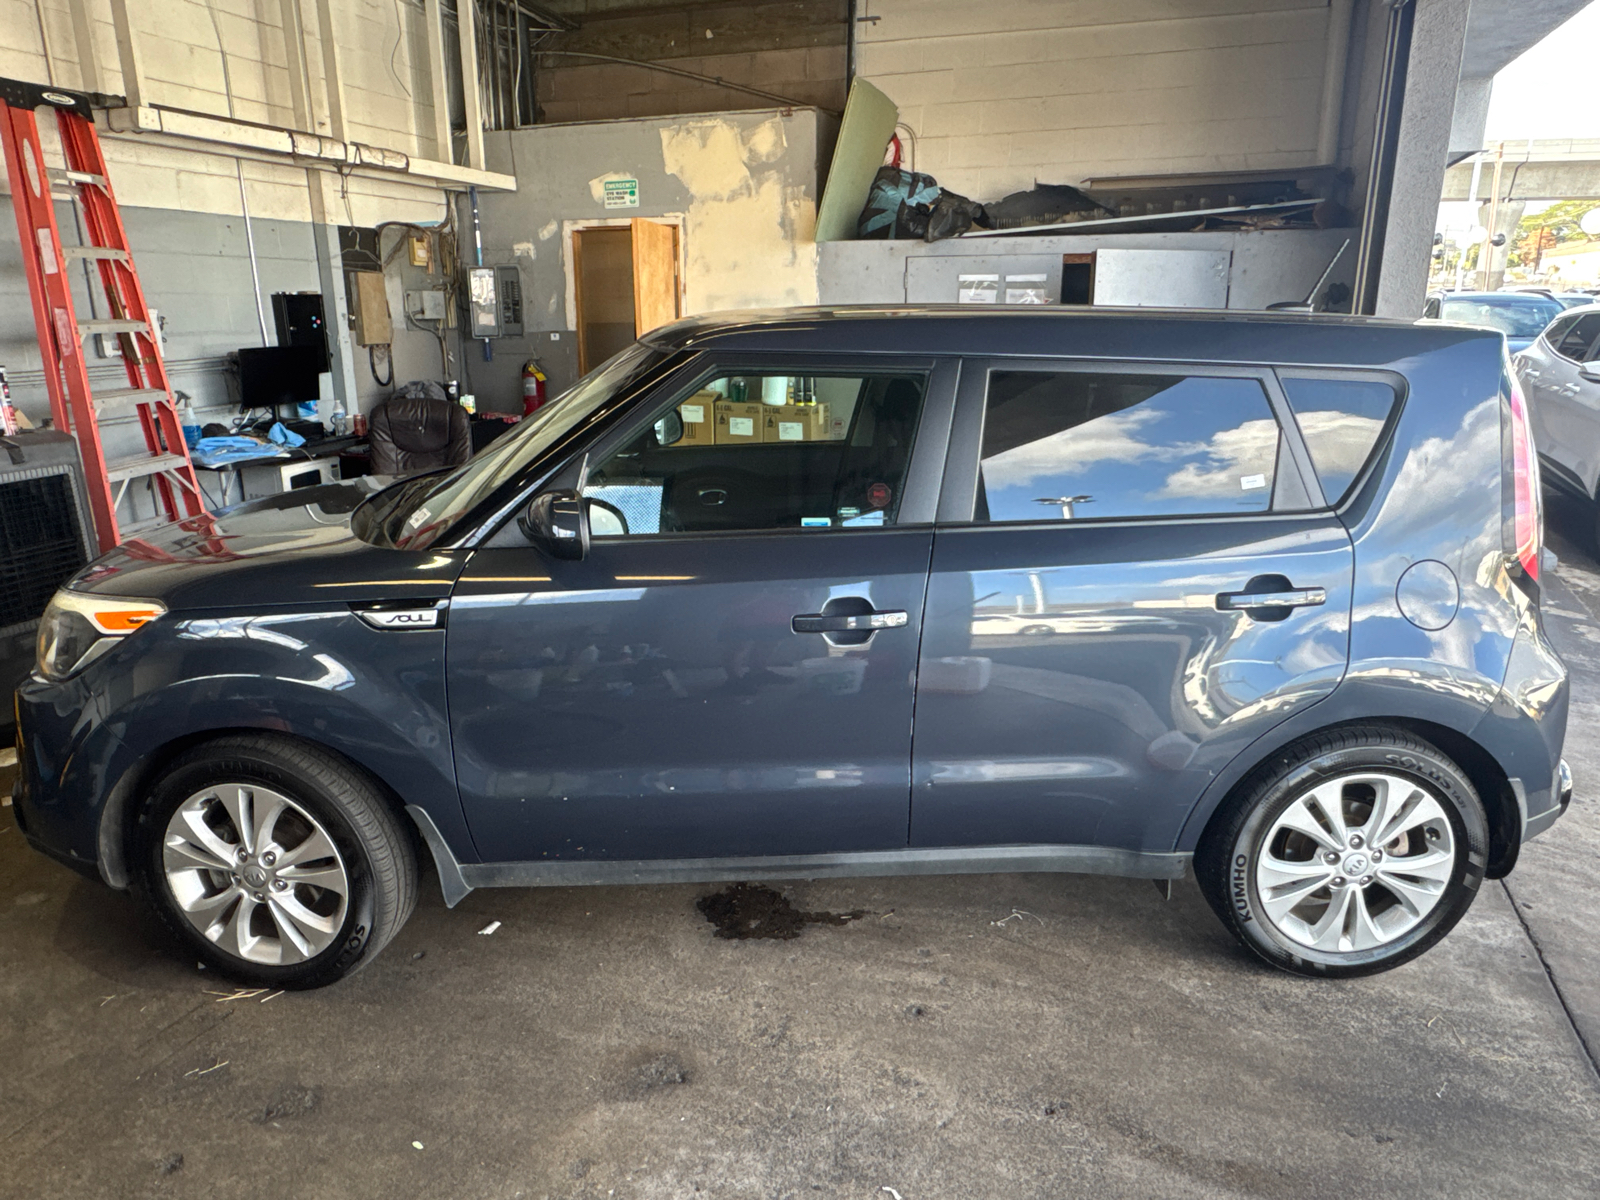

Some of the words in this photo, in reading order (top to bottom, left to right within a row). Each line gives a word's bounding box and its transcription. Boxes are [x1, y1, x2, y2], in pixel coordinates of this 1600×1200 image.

[386, 614, 432, 623] SOUL
[1385, 754, 1454, 790] SOLUS
[1346, 859, 1365, 876] KIA
[1233, 853, 1253, 923] KUMHO
